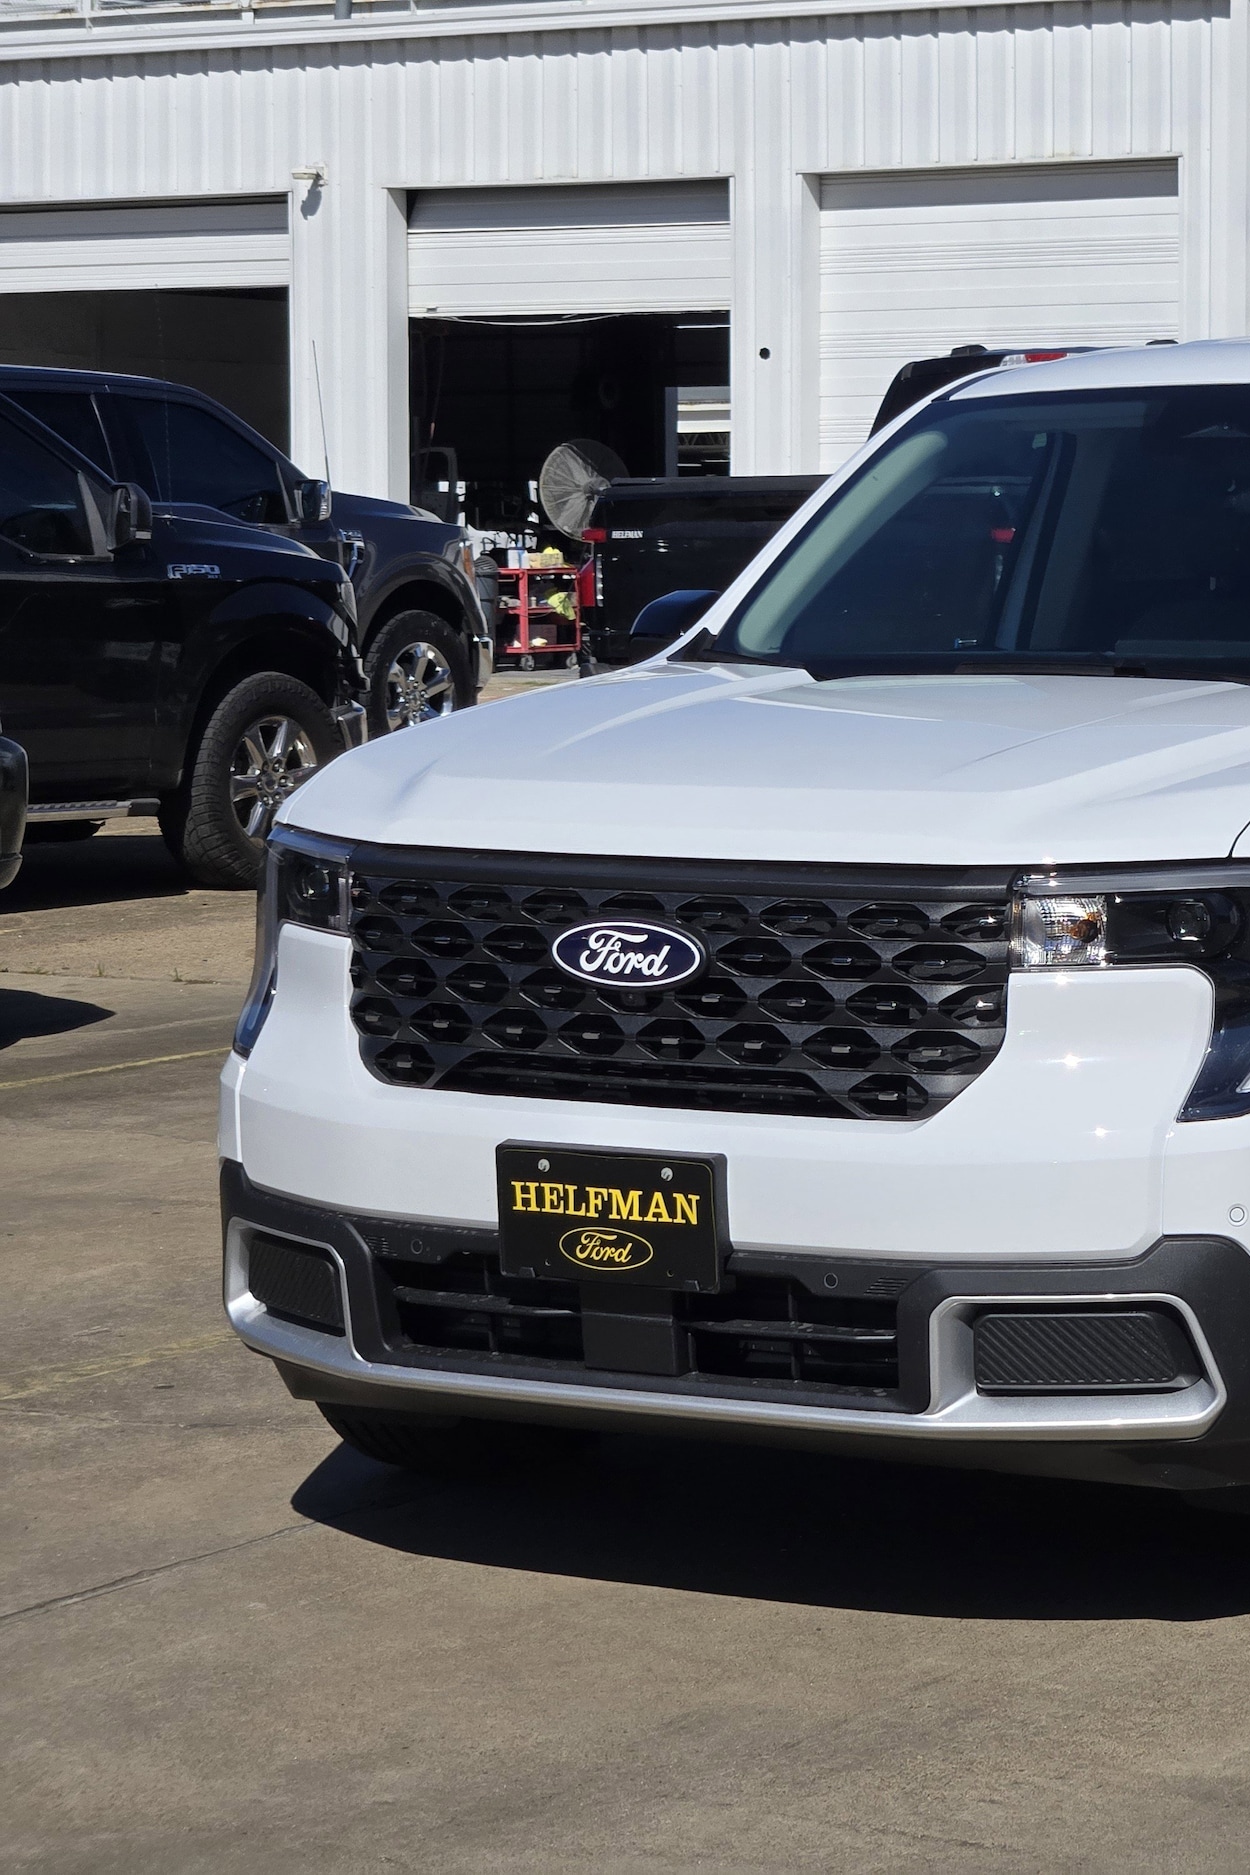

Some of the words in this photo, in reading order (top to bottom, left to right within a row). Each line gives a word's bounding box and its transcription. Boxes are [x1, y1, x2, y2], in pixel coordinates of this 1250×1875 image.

[579, 929, 671, 977] Ford
[511, 1181, 700, 1225] HELFMAN
[575, 1231, 632, 1264] Ford
